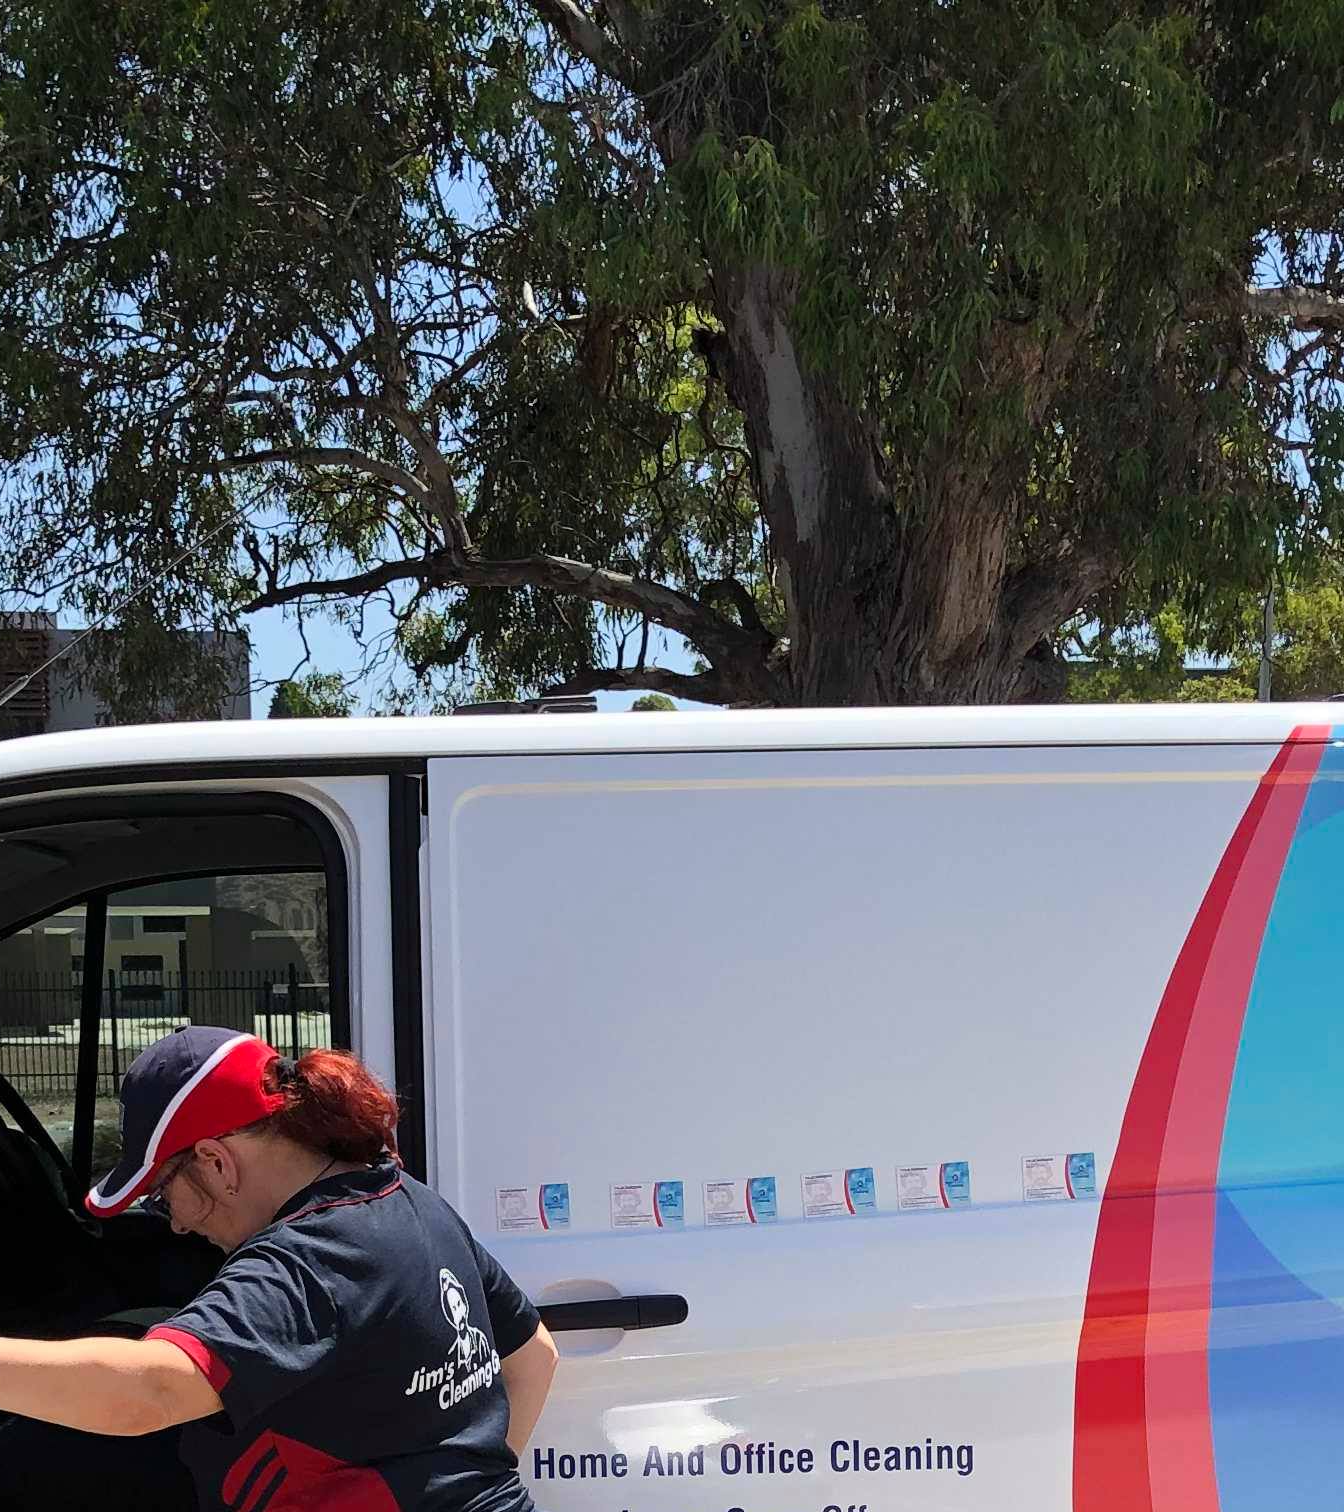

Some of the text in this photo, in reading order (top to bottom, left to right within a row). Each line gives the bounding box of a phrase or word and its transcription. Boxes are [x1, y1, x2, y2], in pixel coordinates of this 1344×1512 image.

[405, 1362, 455, 1396] Jim's
[439, 1361, 493, 1410] Cleaning
[533, 1438, 975, 1480] Home And Office Cleaning
